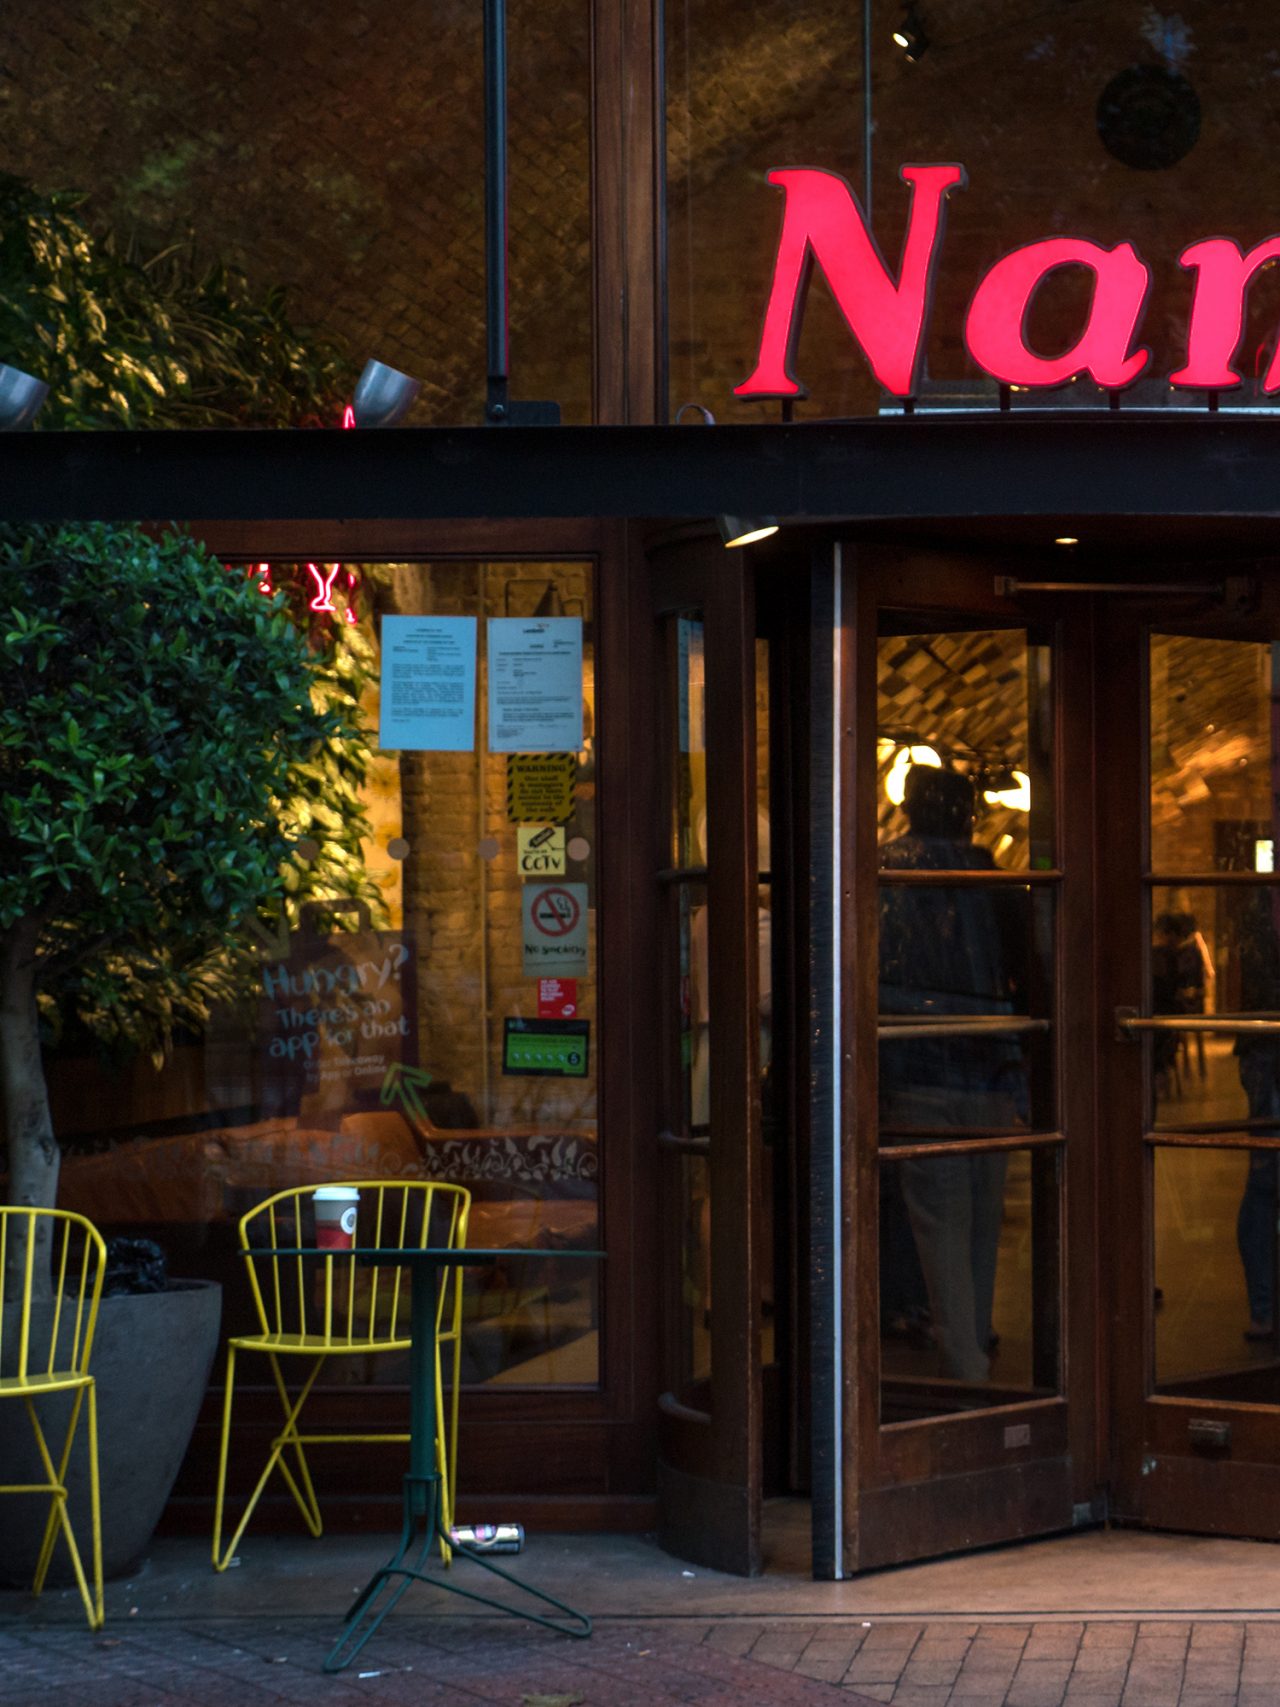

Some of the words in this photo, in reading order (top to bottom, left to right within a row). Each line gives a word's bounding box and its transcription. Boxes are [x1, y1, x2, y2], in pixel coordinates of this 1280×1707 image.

[516, 765, 566, 773] WARNING
[522, 855, 561, 871] CCTV
[263, 943, 409, 1000] Hungry?
[276, 1003, 359, 1030] There's
[363, 999, 391, 1015] an
[269, 1031, 320, 1061] app
[361, 1015, 410, 1040] that
